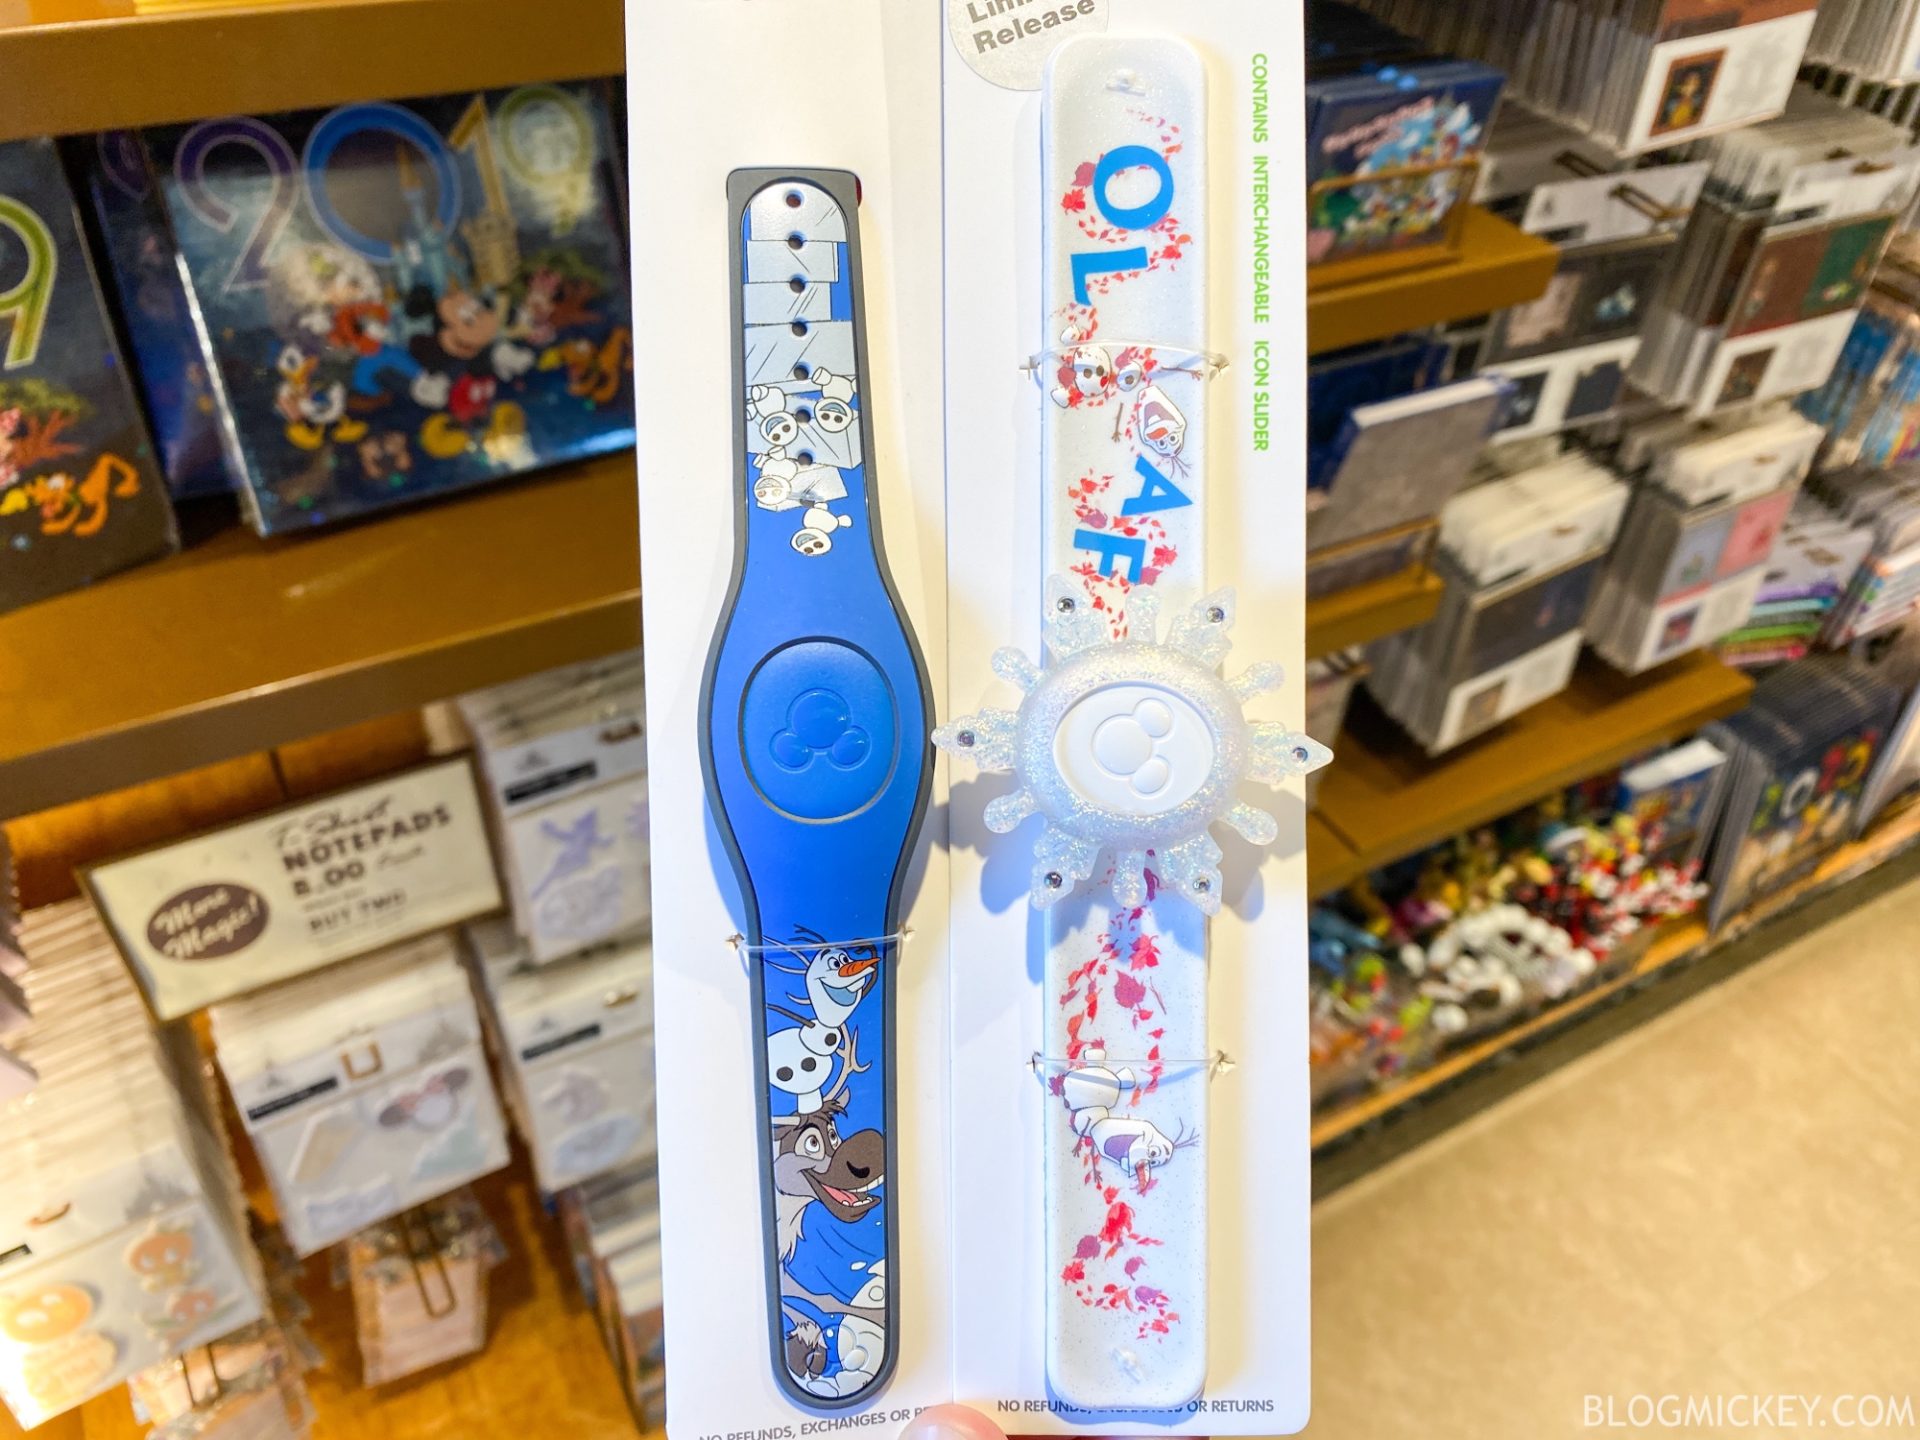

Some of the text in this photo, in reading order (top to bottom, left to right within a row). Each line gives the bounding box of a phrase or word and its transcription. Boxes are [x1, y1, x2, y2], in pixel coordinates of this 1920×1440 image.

[973, 0, 1096, 54] Release
[1252, 53, 1270, 451] CONTAINS INTERCHANGEABLE ICON SLIDER
[1069, 145, 1193, 585] OLAF
[283, 804, 450, 871] NOTEPADS
[153, 887, 231, 936] More
[162, 892, 260, 958] Magic!
[801, 1412, 886, 1436] EXCHANGES
[890, 1408, 911, 1421] OR
[998, 1400, 1020, 1412] NO
[1187, 1400, 1207, 1412] OR
[1211, 1400, 1275, 1412] RETURNS
